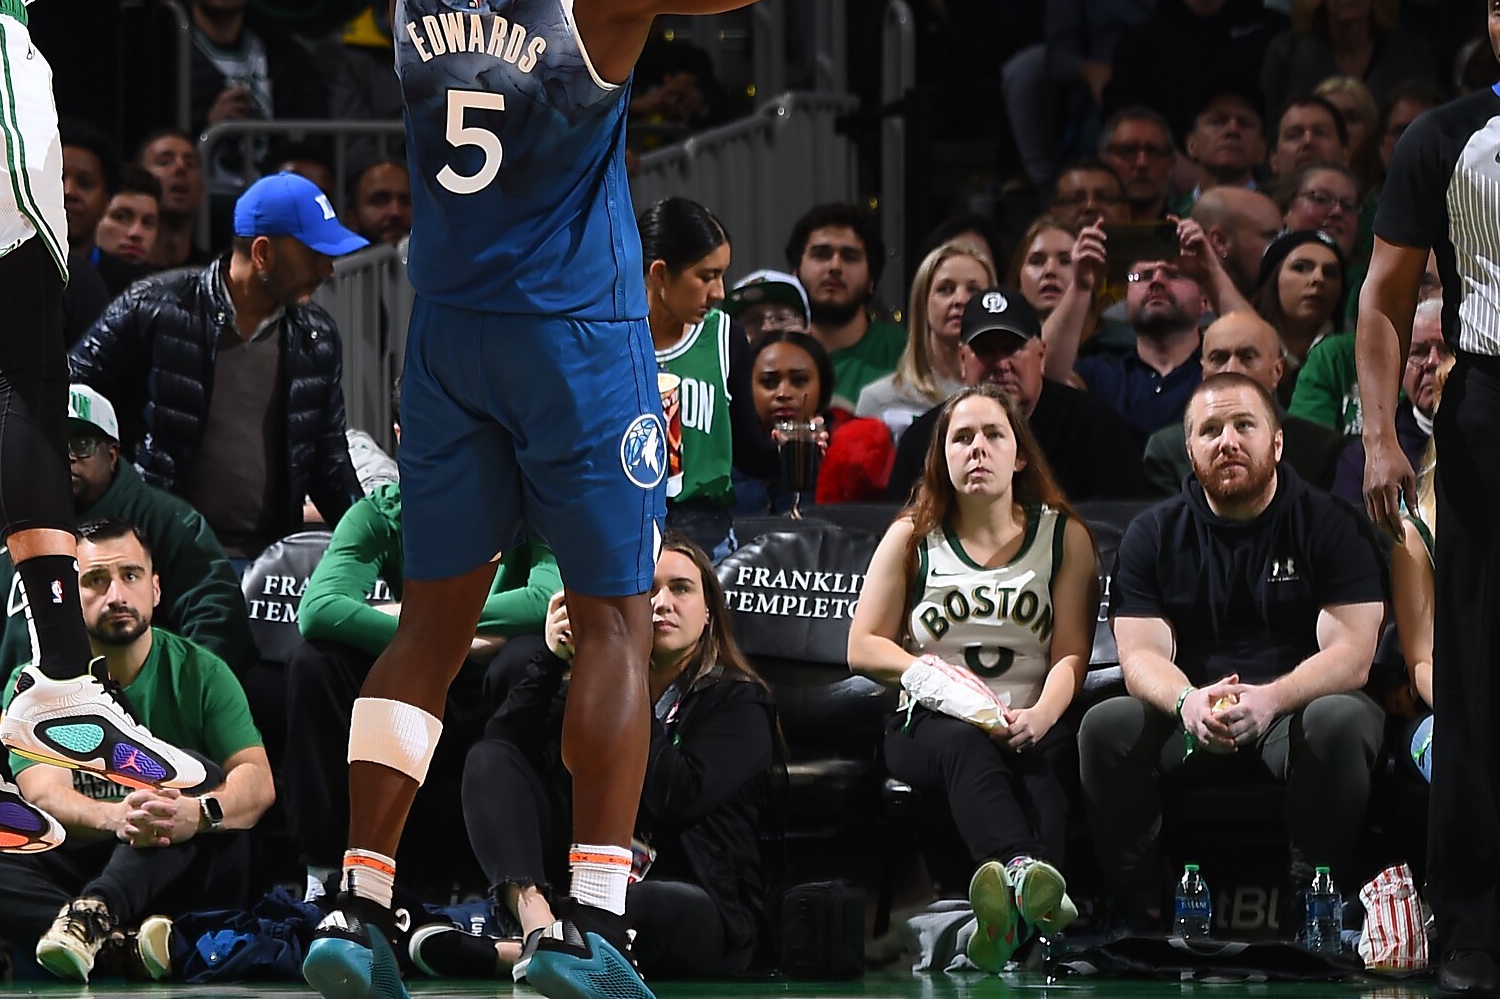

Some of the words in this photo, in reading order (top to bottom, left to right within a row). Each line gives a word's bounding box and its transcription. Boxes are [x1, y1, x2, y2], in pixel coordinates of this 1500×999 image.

[406, 12, 547, 74] EDWARDS
[435, 89, 506, 194] 5
[736, 566, 866, 594] FRANKLI
[919, 585, 1053, 644] BOSTON
